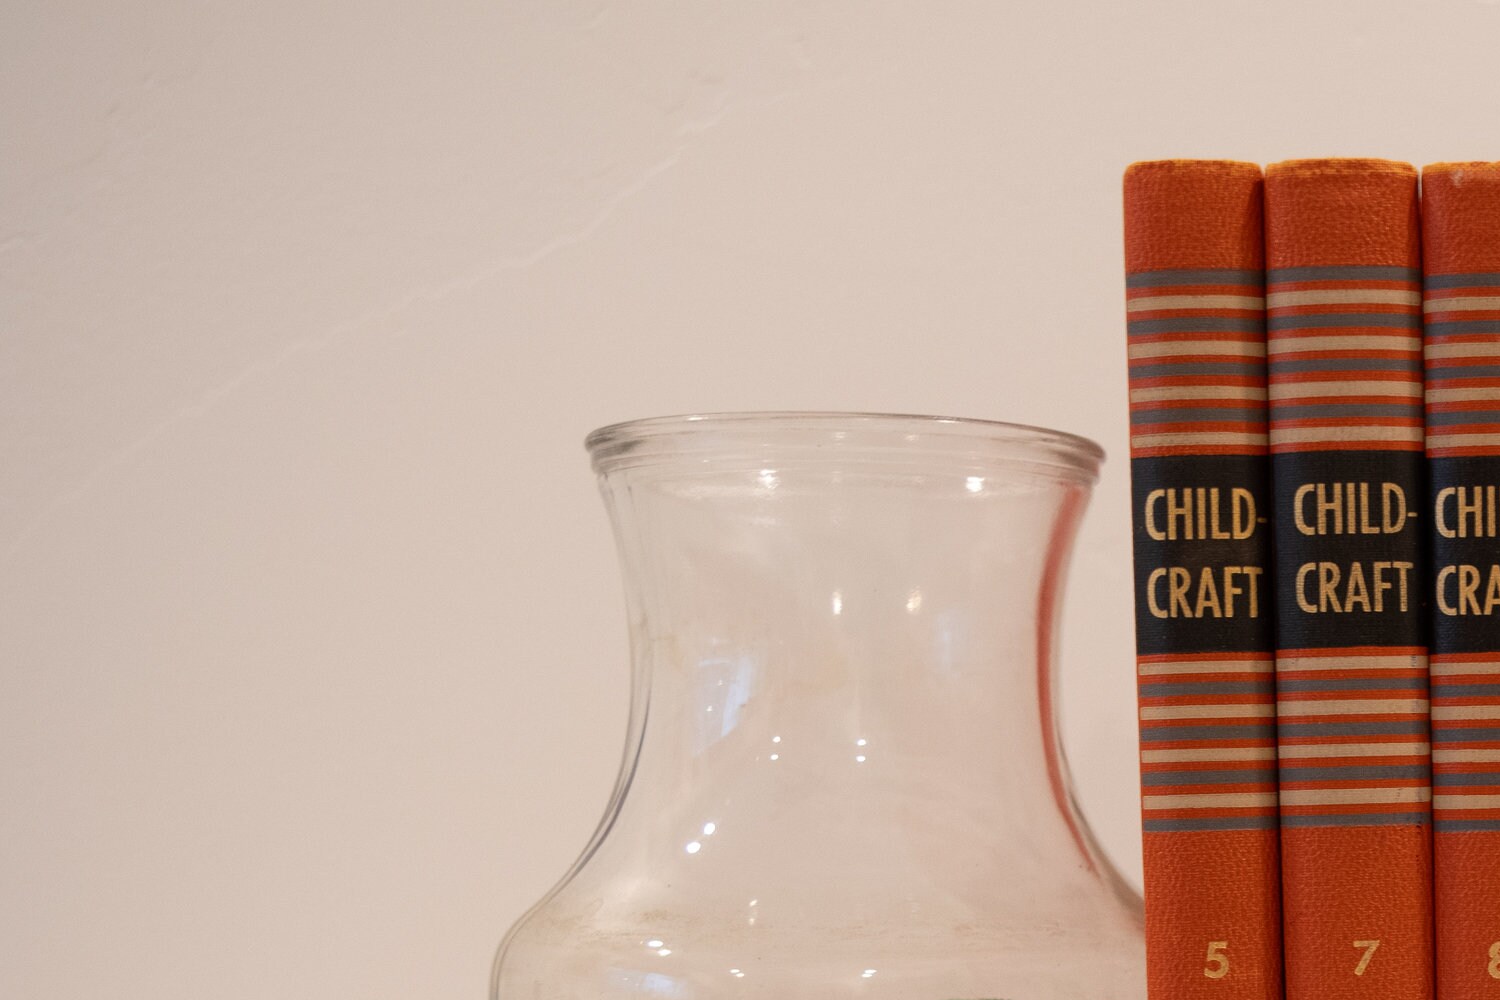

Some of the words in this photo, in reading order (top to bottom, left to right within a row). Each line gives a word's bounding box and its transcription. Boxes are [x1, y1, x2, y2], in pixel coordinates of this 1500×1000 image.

[1144, 487, 1268, 541] CHILD-
[1293, 481, 1418, 535] CHILD-
[1147, 566, 1263, 619] CRAFT
[1295, 561, 1414, 614] CRAFT
[1203, 940, 1230, 979] 5
[1352, 940, 1380, 976] 7
